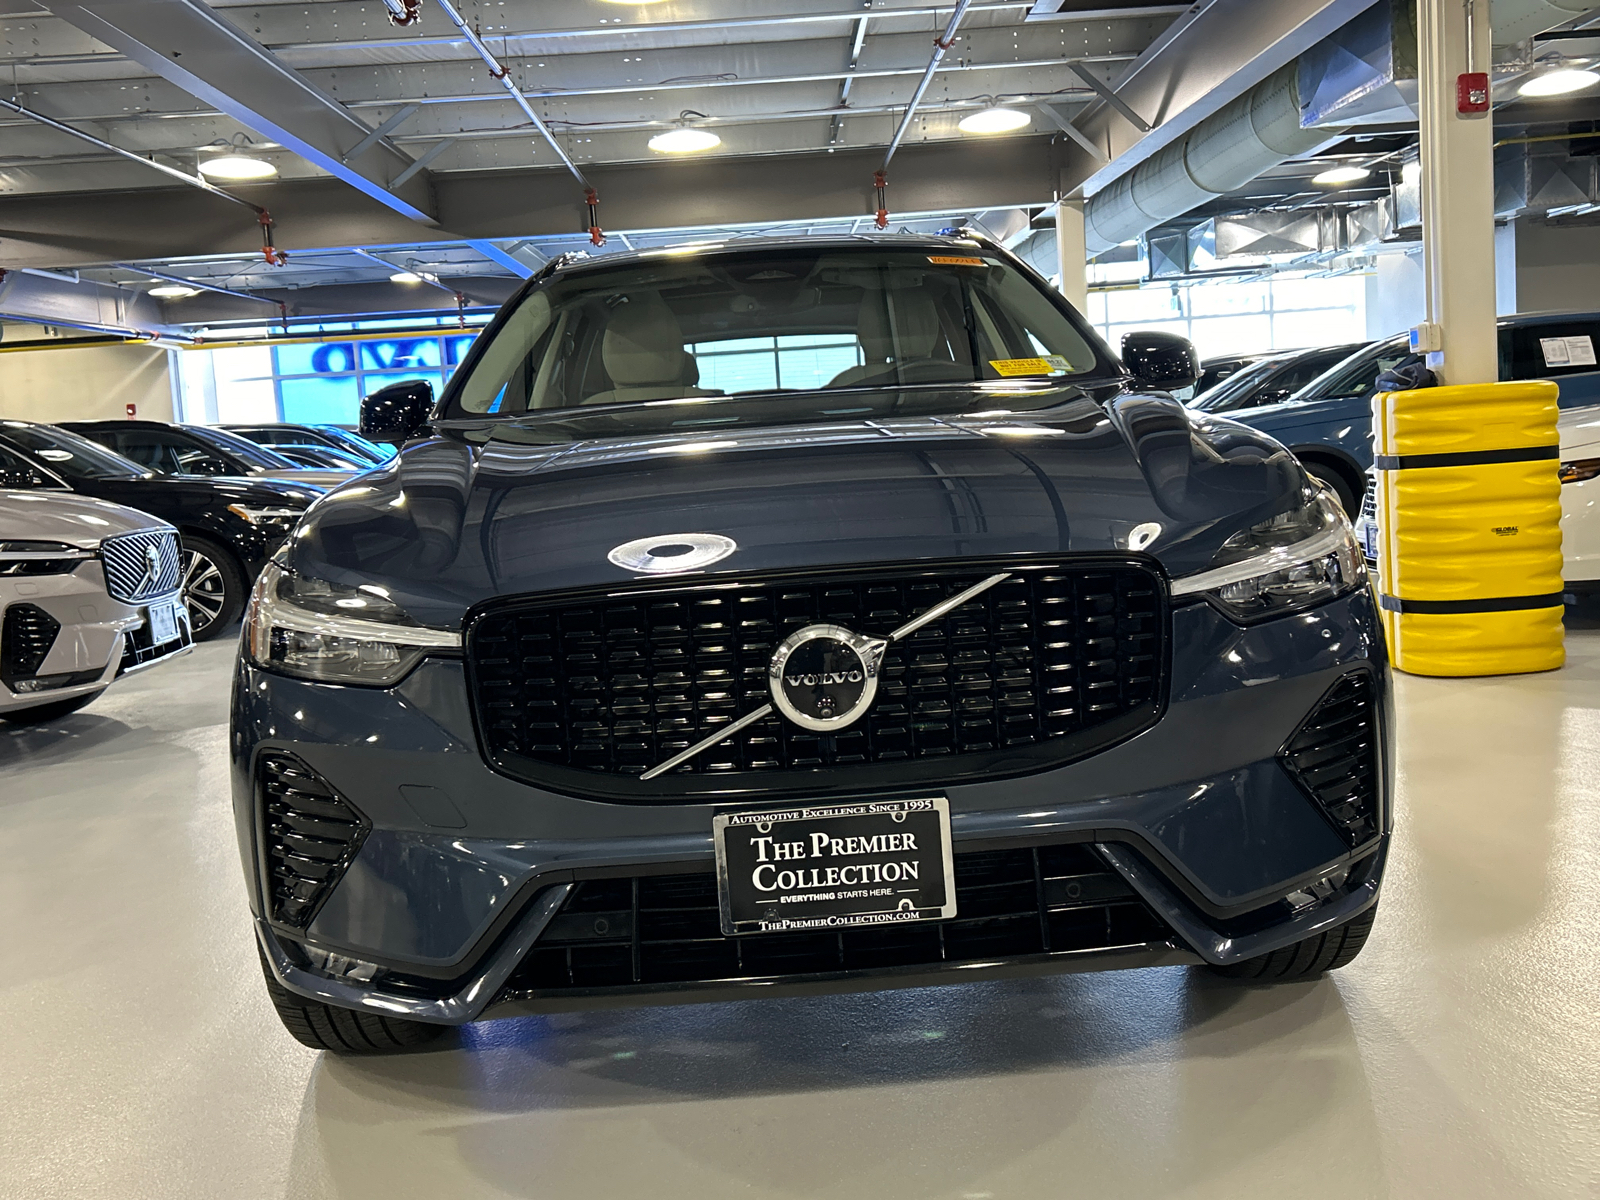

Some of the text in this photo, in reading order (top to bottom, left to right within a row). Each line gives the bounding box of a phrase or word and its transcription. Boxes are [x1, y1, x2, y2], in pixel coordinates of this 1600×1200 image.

[785, 670, 863, 687] VOLVO
[731, 799, 932, 825] AUTOMOTIVE EXCELLENCE SINCE 1995
[750, 832, 918, 863] THE PREMIER
[752, 860, 920, 892] COLLECTION
[780, 887, 895, 904] EVERYTHING STARTS HERE.
